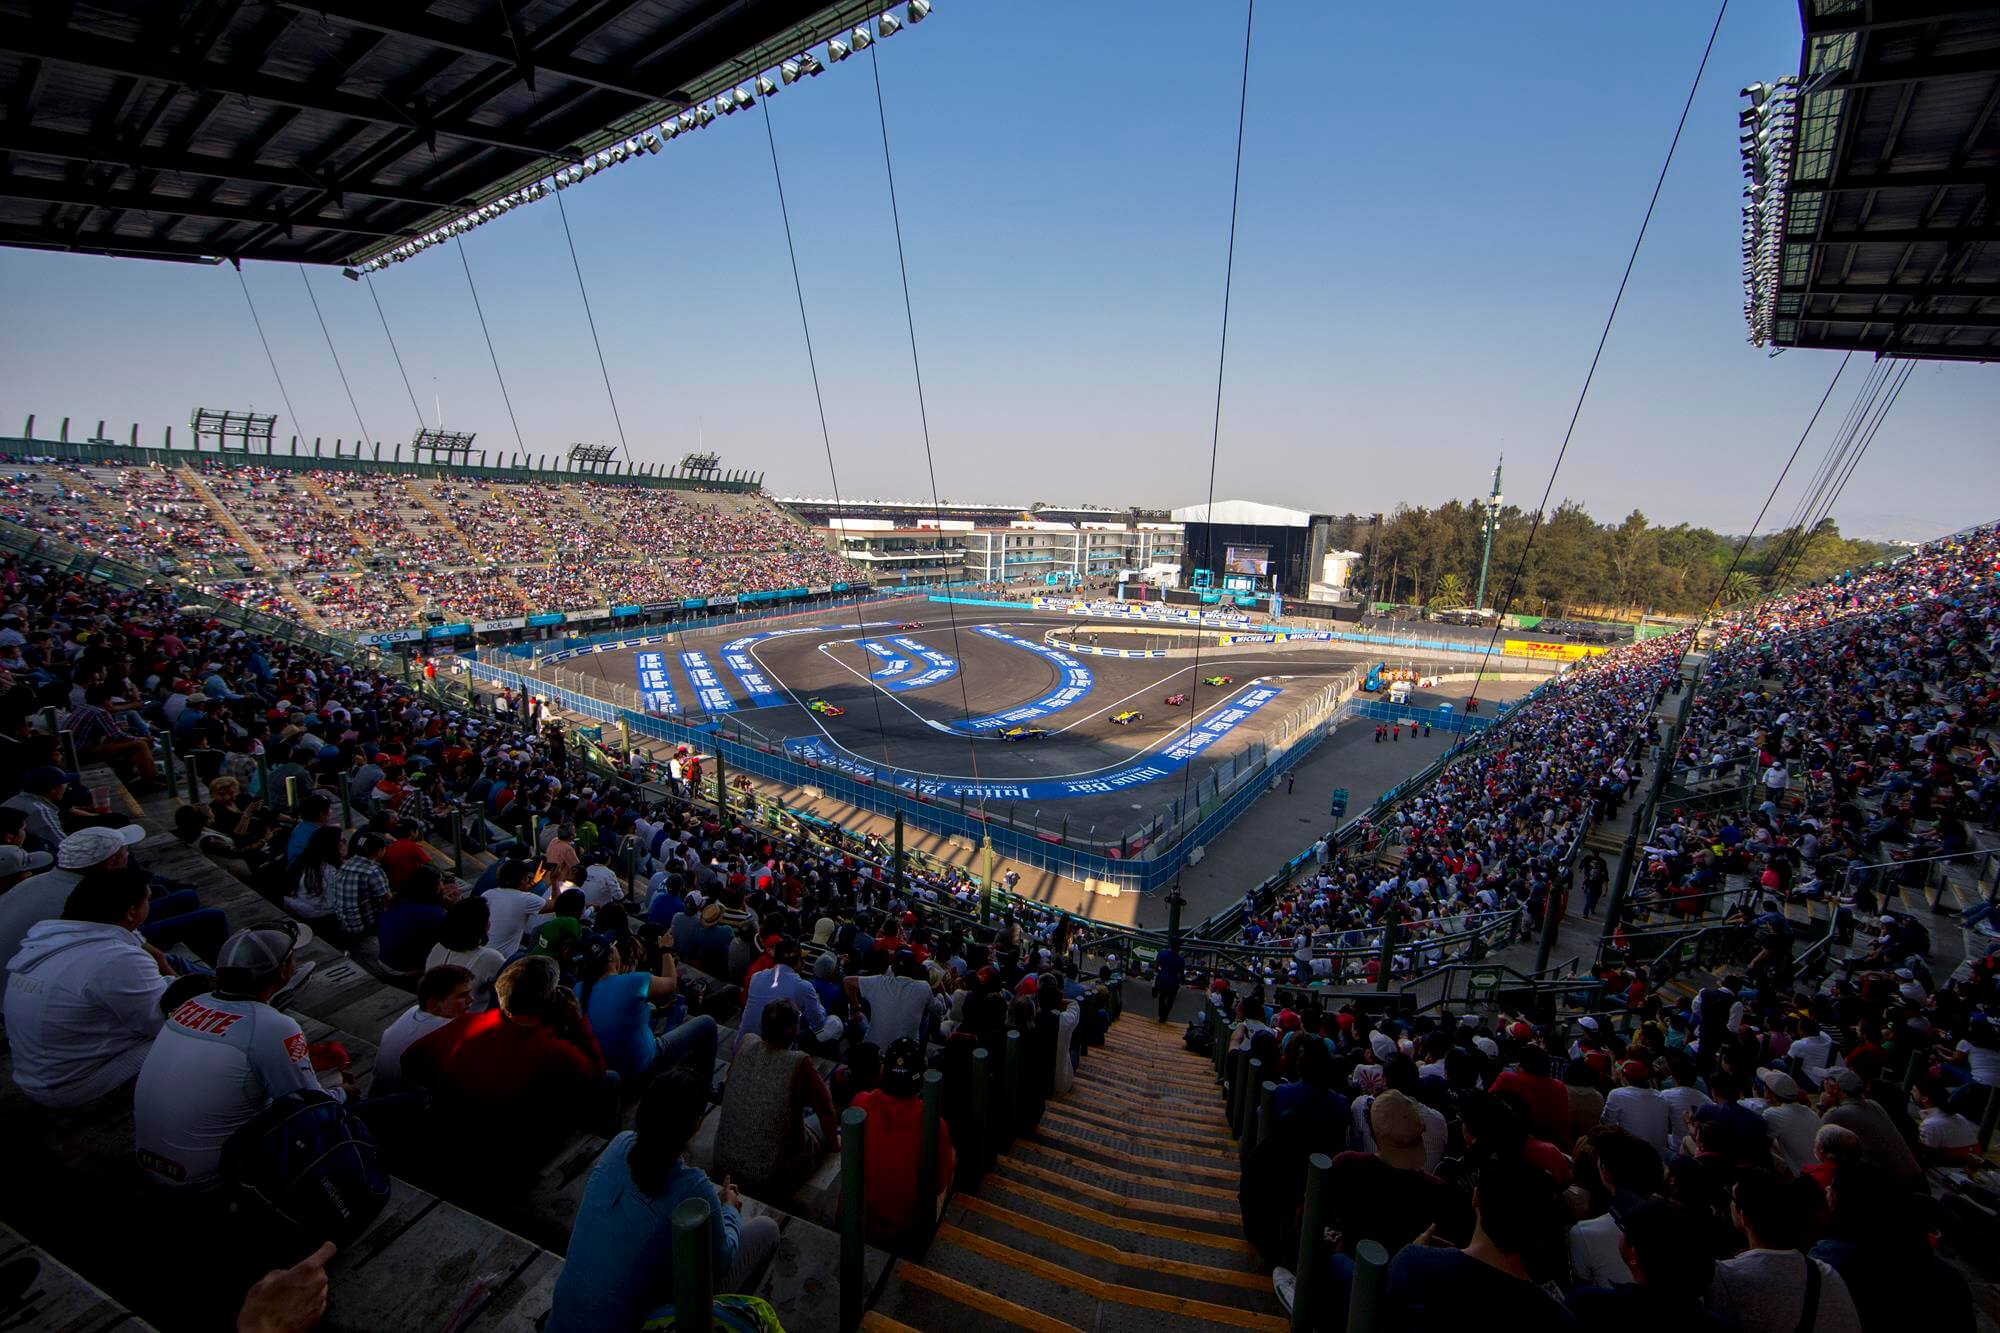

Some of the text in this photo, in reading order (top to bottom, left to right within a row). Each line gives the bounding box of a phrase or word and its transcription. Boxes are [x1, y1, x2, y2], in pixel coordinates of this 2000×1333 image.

[1145, 607, 1188, 617] MICHELIN
[486, 621, 513, 630] OCESA
[370, 632, 410, 643] OCESA
[1235, 635, 1274, 643] MICHELIN
[1290, 632, 1329, 640] MICHELIN
[1068, 766, 1168, 793] Julius Bär
[953, 787, 1031, 798] Julius
[173, 999, 245, 1034] TECATE
